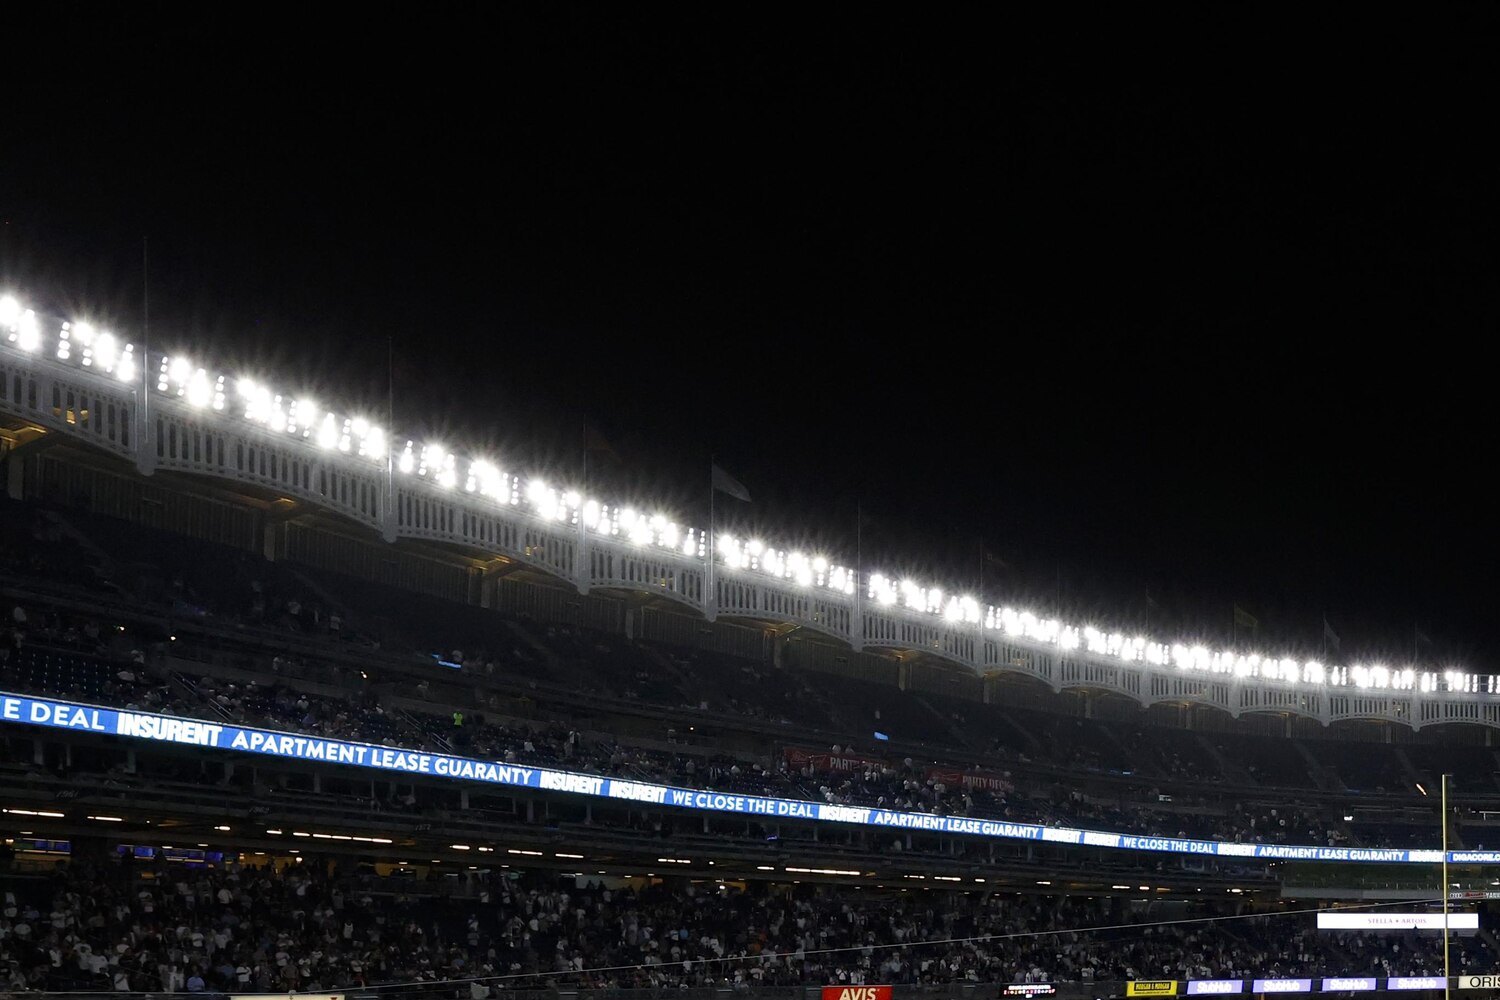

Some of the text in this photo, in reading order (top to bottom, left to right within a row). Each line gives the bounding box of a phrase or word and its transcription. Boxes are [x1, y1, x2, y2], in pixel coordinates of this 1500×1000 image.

[4, 699, 105, 730] E DEAL
[117, 712, 533, 785] INSURENT APARTMENT LEASE GUARANTY
[672, 790, 813, 818] WE CLOSE THE DEAL
